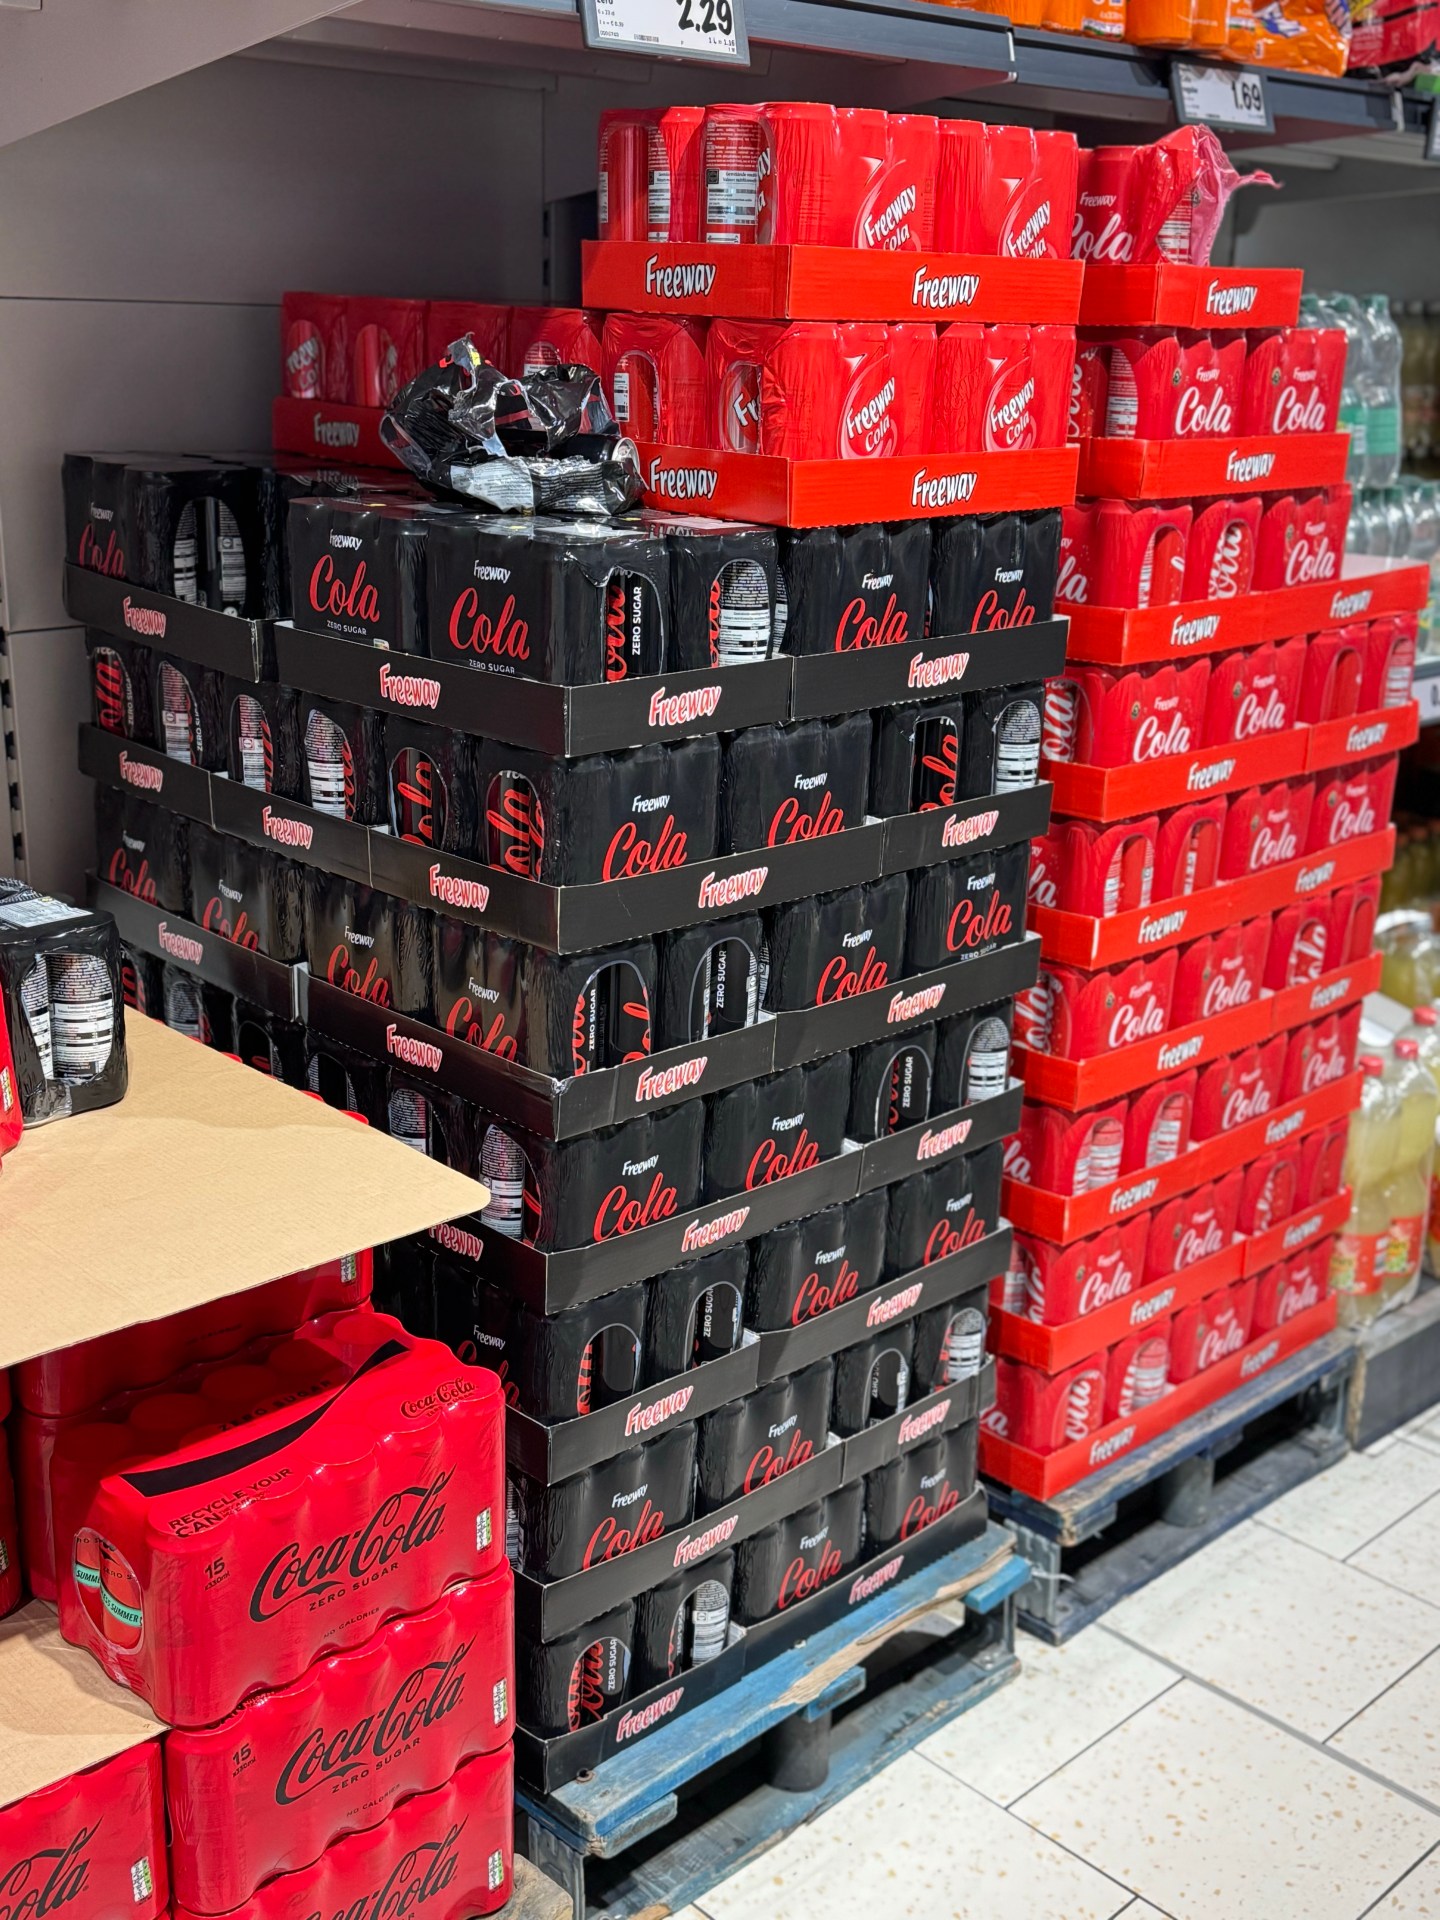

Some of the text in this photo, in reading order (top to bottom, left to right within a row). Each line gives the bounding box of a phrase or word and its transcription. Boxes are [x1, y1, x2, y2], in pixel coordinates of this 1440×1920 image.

[676, 0, 732, 35] 2.29
[1231, 80, 1262, 111] 1.69
[864, 184, 916, 246] Freeway
[1080, 191, 1117, 207] Freeway
[1007, 200, 1051, 257] Freeway
[645, 253, 717, 299] Freeway
[912, 265, 981, 309] Freeway
[1206, 278, 1257, 315] Freeway
[1196, 366, 1220, 382] Freeway
[1292, 367, 1317, 382] Freeway
[846, 376, 897, 440] Freeway
[989, 377, 1036, 433] Freeway
[1174, 385, 1232, 436] Cola
[1272, 385, 1326, 435] Cola
[314, 412, 360, 448] Freeway
[865, 415, 891, 452] Cola
[1006, 412, 1031, 446] Cola
[649, 456, 718, 500] Freeway
[1226, 449, 1275, 483] Freeway
[911, 468, 978, 510] Freeway
[79, 523, 126, 578] Cola
[329, 529, 363, 550] Freeway
[473, 559, 511, 584] Freeway
[862, 573, 894, 590] Freeway
[994, 567, 1024, 583] Freeway
[1285, 538, 1336, 587] Cola
[309, 554, 381, 623] Cola
[1330, 590, 1373, 619] Freeway
[123, 596, 167, 638] Freeway
[327, 619, 367, 636] ZERO SUGAR
[449, 587, 530, 661] Cola
[632, 586, 643, 656] ZERO SUGAR
[835, 592, 908, 653] Cola
[970, 588, 1036, 634] Cola
[1170, 612, 1220, 647] Freeway
[379, 662, 441, 710] Freeway
[468, 658, 516, 675] ZERO SUGAR
[907, 651, 970, 689] Freeway
[648, 685, 722, 727] Freeway
[1153, 695, 1179, 710] Freeway
[1234, 689, 1286, 741] Cola
[1132, 711, 1191, 764] Cola
[1346, 722, 1388, 752] Freeway
[119, 750, 163, 793] Freeway
[794, 772, 828, 790] Freeway
[1187, 758, 1236, 791] Freeway
[632, 795, 670, 813] Freeway
[767, 791, 846, 848] Cola
[1329, 796, 1376, 845] Cola
[262, 805, 313, 850] Freeway
[602, 815, 688, 883] Cola
[941, 810, 1000, 847] Freeway
[1250, 822, 1296, 870] Cola
[109, 848, 158, 906] Cola
[218, 879, 243, 903] Freeway
[429, 863, 490, 912] Freeway
[699, 866, 768, 908] Freeway
[967, 872, 996, 891] Freeway
[1295, 860, 1336, 894] Freeway
[202, 897, 259, 950] Cola
[344, 925, 375, 948] Freeway
[842, 929, 872, 948] Freeway
[947, 890, 1012, 952] Cola
[1137, 909, 1188, 944] Freeway
[158, 922, 203, 965] Freeway
[327, 944, 390, 1008] Cola
[468, 976, 500, 1004] Freeway
[716, 950, 727, 1008] ZERO SUGAR
[816, 946, 888, 1007] Cola
[1202, 969, 1251, 1019] Cola
[1309, 977, 1352, 1009] Freeway
[588, 989, 597, 1051] ZERO SUGAR
[887, 984, 946, 1023] Freeway
[1108, 1001, 1164, 1049] Cola
[386, 1023, 443, 1073] Freeway
[446, 997, 518, 1062] Cola
[1157, 1035, 1204, 1071] Freeway
[1302, 1050, 1347, 1094] Cola
[635, 1056, 708, 1102] Freeway
[902, 1056, 913, 1108] ZERO SUGAR
[772, 1112, 804, 1131] Freeway
[1221, 1085, 1271, 1132] Cola
[1264, 1109, 1306, 1145] Freeway
[746, 1128, 820, 1192] Cola
[917, 1118, 972, 1160] Freeway
[621, 1153, 659, 1177] Freeway
[593, 1171, 678, 1242] Cola
[945, 1193, 973, 1212] Freeway
[1108, 1177, 1160, 1214] Freeway
[681, 1206, 750, 1252] Freeway
[923, 1208, 986, 1267] Cola
[1173, 1219, 1223, 1272] Cola
[1282, 1215, 1324, 1249] Freeway
[815, 1245, 846, 1264] Freeway
[792, 1260, 859, 1326] Cola
[867, 1282, 923, 1328] Freeway
[1077, 1263, 1132, 1316] Cola
[1130, 1287, 1177, 1326] Freeway
[1277, 1282, 1318, 1325] Cola
[473, 1324, 506, 1350] Freeway
[704, 1314, 712, 1338] ZERO
[1199, 1324, 1244, 1368] Cola
[1240, 1341, 1280, 1378] Freeway
[400, 1376, 476, 1419] Coca-Cola
[625, 1385, 694, 1437] Freeway
[768, 1414, 798, 1438] Freeway
[898, 1399, 951, 1444] Freeway
[743, 1428, 815, 1496] Cola
[1090, 1425, 1137, 1465] Freeway
[168, 1489, 247, 1530] RECYCLE
[248, 1467, 293, 1492] YOUR
[611, 1483, 649, 1508] Freeway
[920, 1467, 947, 1490] Freeway
[175, 1511, 222, 1539] CAN
[901, 1480, 960, 1541] Cola
[249, 1461, 459, 1625] Coca-Cola
[582, 1499, 665, 1571] Cola
[673, 1515, 739, 1569] Freeway
[800, 1526, 829, 1551] Freeway
[76, 1569, 100, 1584] SUMM
[204, 1557, 226, 1580] 15
[309, 1560, 400, 1613] ZERO SUGAR
[777, 1539, 842, 1610] Cola
[848, 1554, 905, 1605] Freeway
[110, 1602, 139, 1623] SUMMER
[607, 1637, 618, 1691] ZERO SUGAR
[275, 1634, 479, 1806] Coca-Cola
[616, 1686, 684, 1743] Freeway
[232, 1743, 252, 1767] 15
[332, 1736, 421, 1794] ZERO SUGAR
